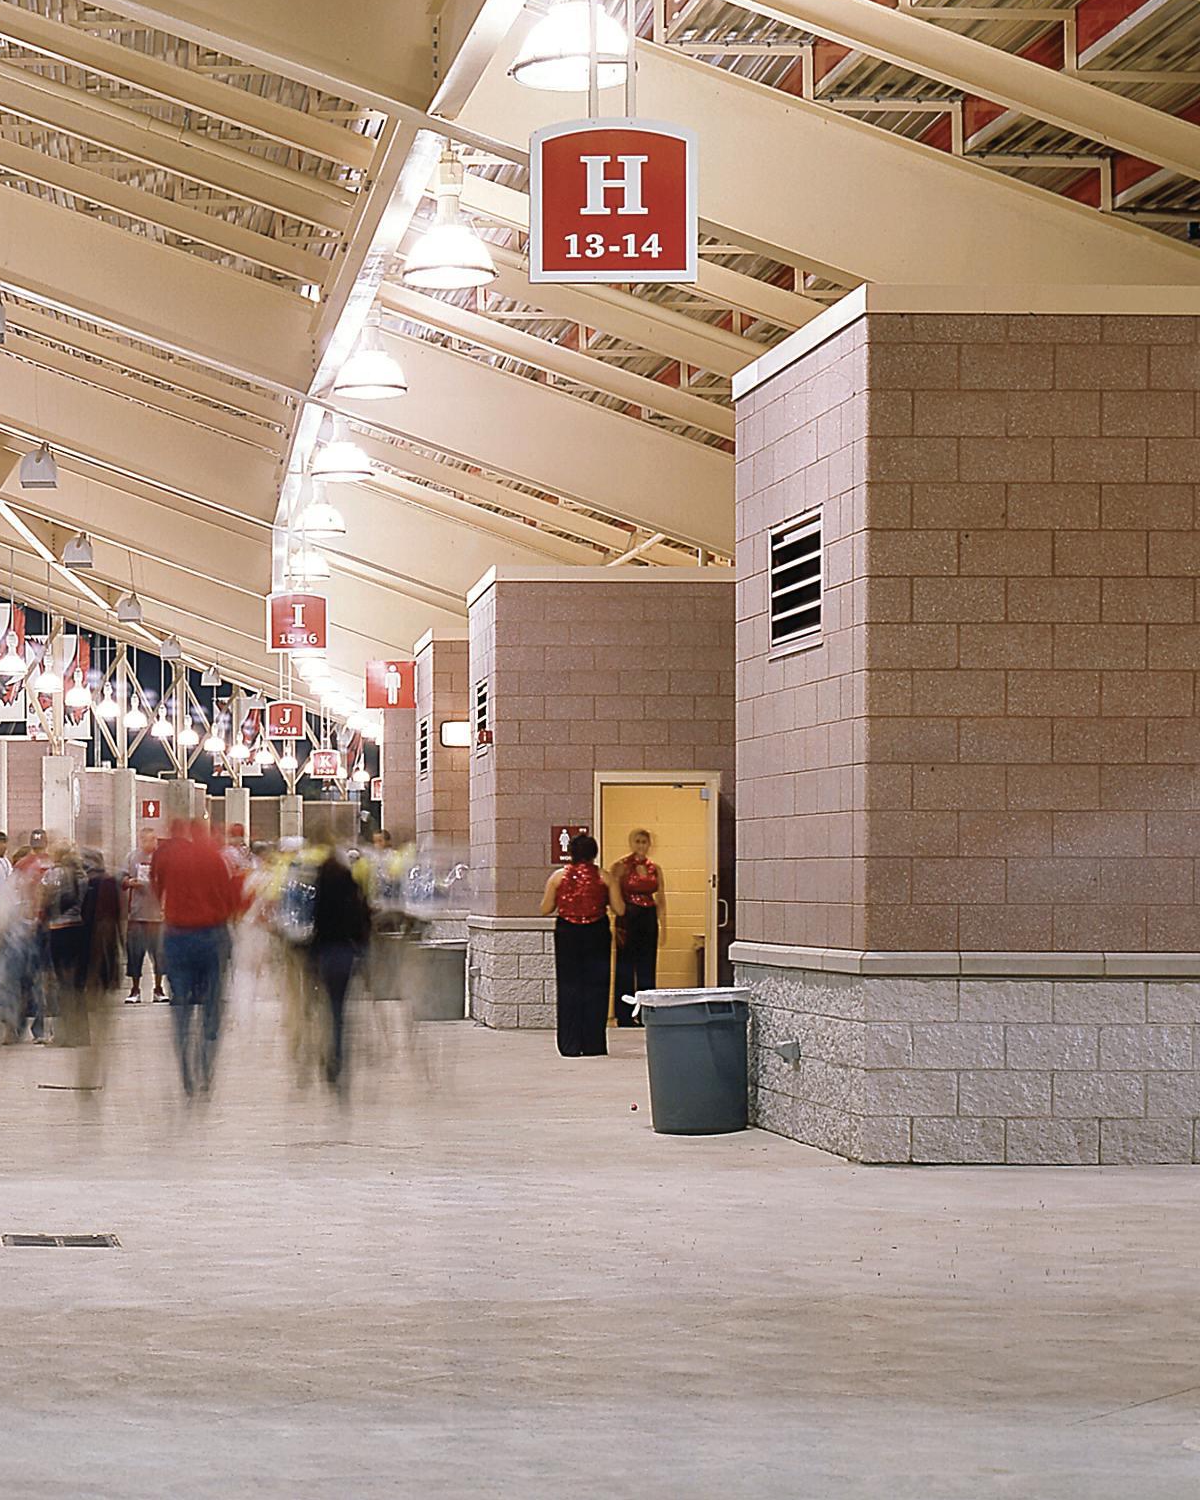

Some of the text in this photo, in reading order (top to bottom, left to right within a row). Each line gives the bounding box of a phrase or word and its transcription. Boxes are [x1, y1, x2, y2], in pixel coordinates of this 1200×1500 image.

[579, 155, 649, 215] H
[564, 233, 663, 258] 13-14
[291, 603, 306, 628] I
[279, 633, 318, 644] 15-16
[280, 708, 292, 725] J
[319, 755, 332, 767] K
